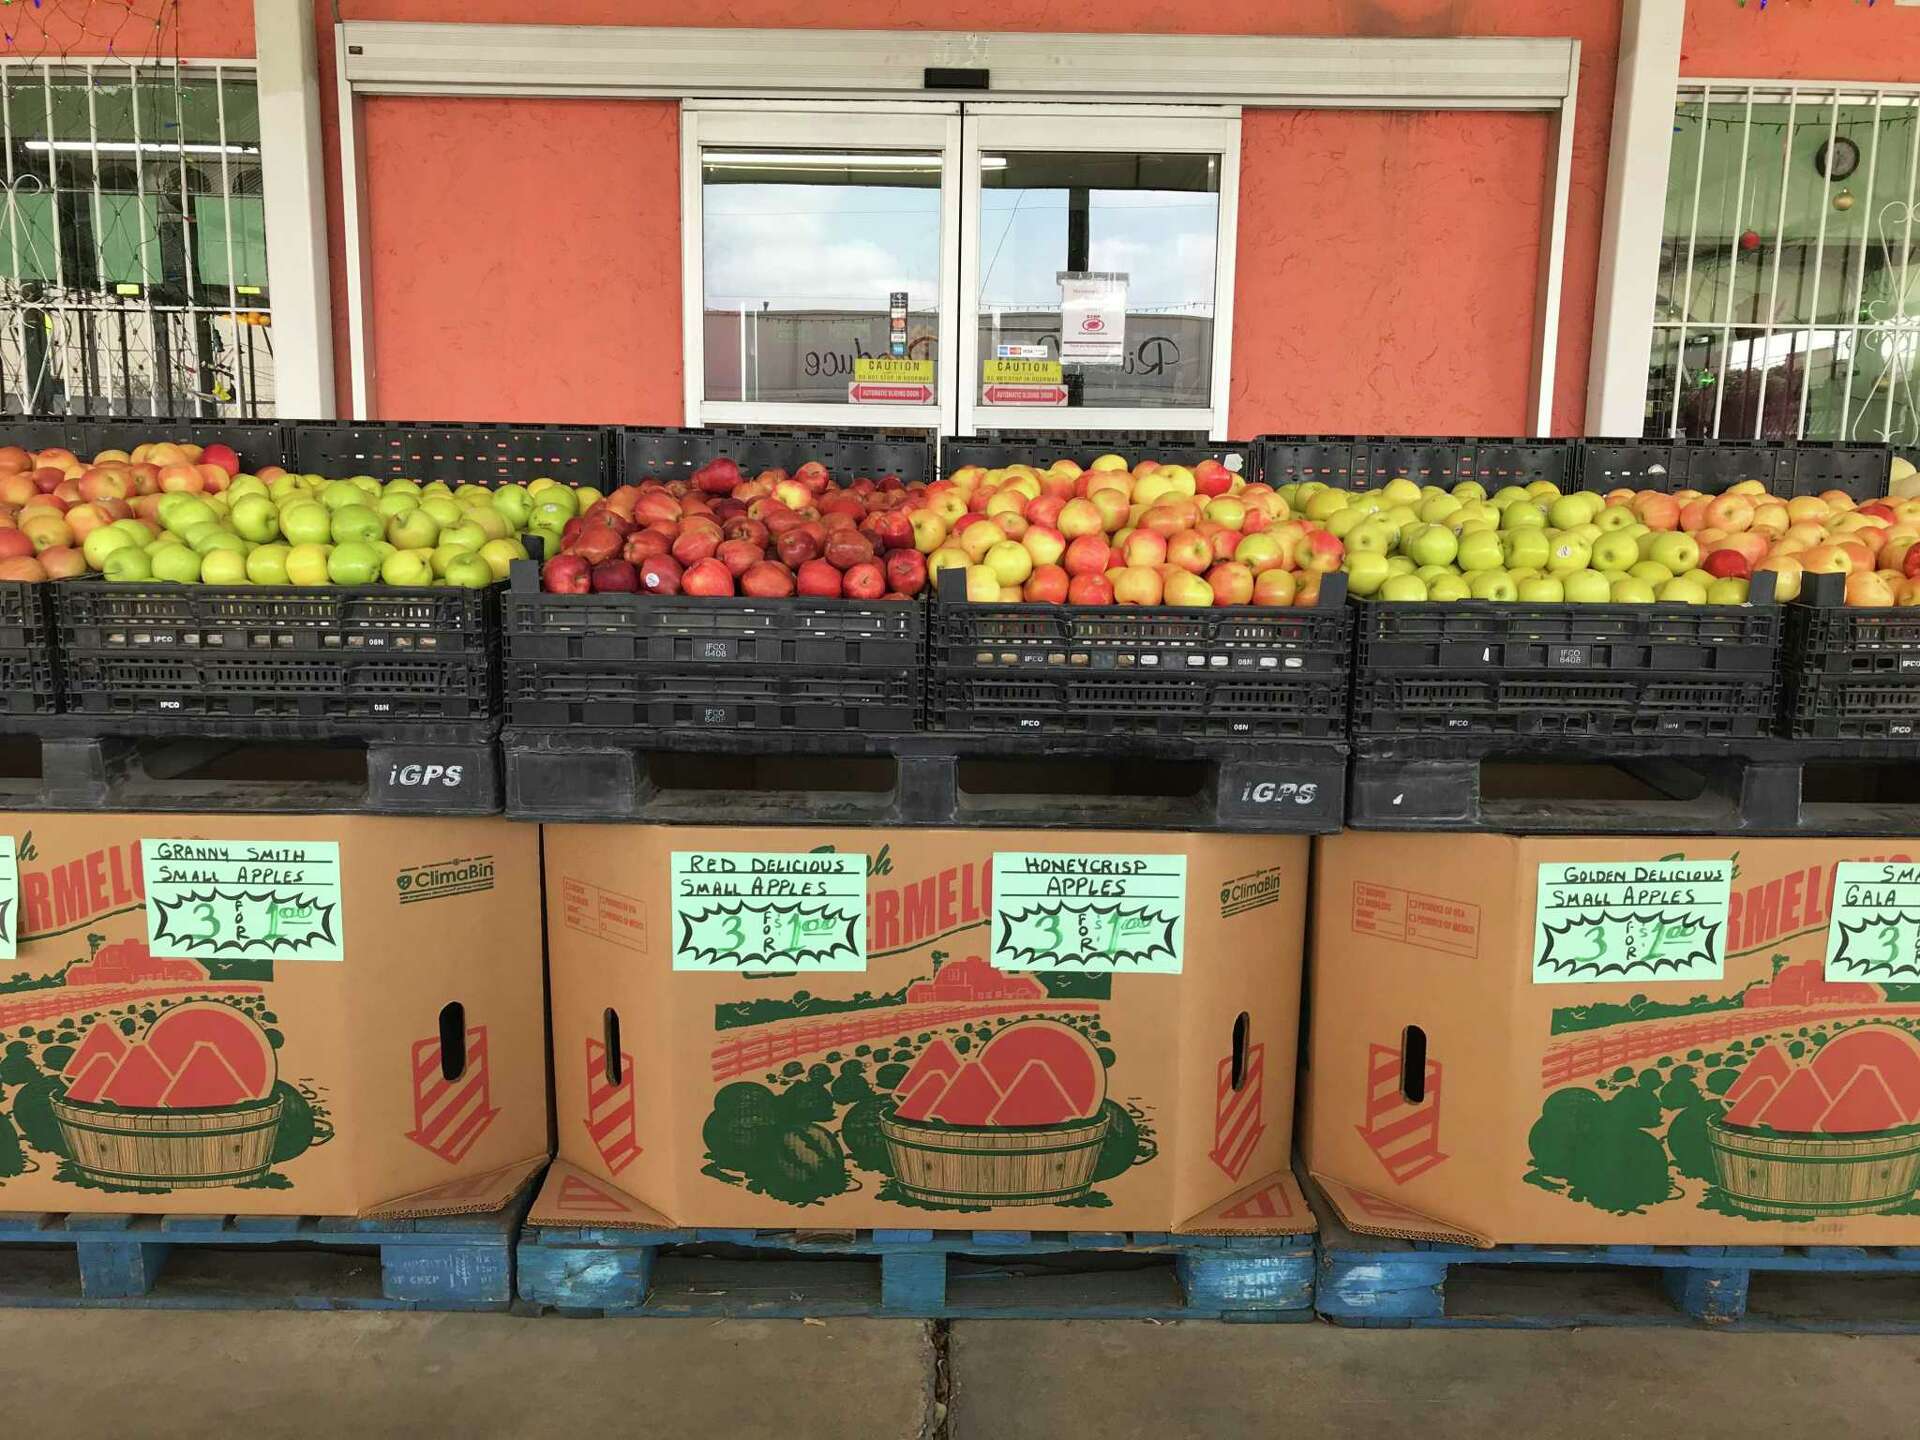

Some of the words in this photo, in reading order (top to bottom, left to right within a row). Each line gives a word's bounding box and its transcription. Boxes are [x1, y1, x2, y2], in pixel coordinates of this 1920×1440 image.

[868, 361, 920, 371] CAUTION
[997, 361, 1049, 372] CAUTION
[706, 642, 727, 650] IFCO
[388, 764, 463, 787] iGPS
[1241, 782, 1317, 804] iGPS
[157, 843, 229, 861] GRANNY
[249, 846, 305, 862] SMITH
[691, 855, 736, 872] RED
[751, 855, 844, 873] DELICIOUS
[1025, 857, 1147, 873] HONEYCRISP
[1564, 867, 1626, 881] GOLDEN
[1634, 867, 1722, 881] DELICIOUS
[159, 866, 219, 883] SMALL
[237, 866, 304, 884] APPLES
[415, 864, 493, 887] ClimaBin
[680, 879, 740, 896] SMALL
[752, 877, 827, 896] APPLES
[1046, 876, 1126, 896] APPLES
[1231, 874, 1280, 901] ClimaBin
[1553, 890, 1610, 906] SMALL
[1623, 886, 1695, 905] APPLES
[1845, 884, 1896, 907] GALA
[190, 903, 221, 941] 3
[716, 915, 746, 952] 3
[1034, 915, 1063, 953] 3
[1574, 926, 1608, 962] 3
[1869, 926, 1900, 965] 3
